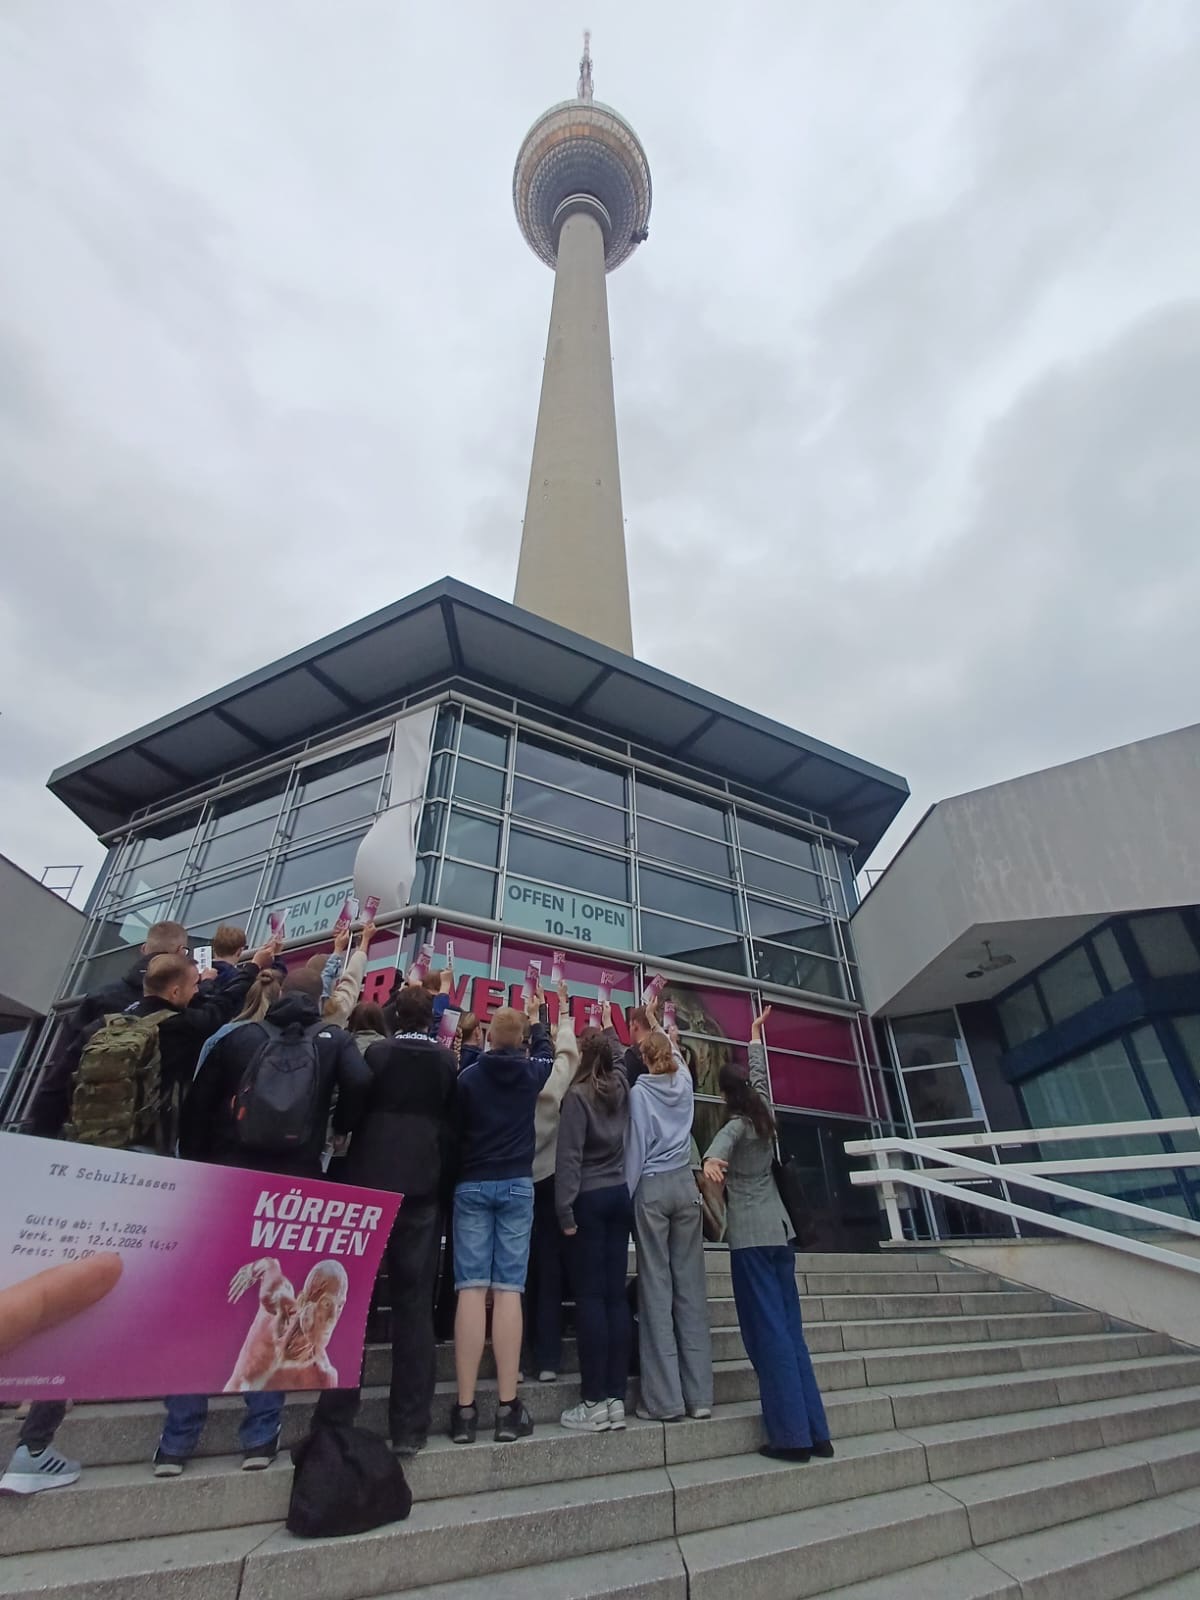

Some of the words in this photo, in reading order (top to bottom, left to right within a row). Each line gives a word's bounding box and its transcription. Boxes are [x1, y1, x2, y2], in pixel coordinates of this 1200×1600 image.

[508, 885, 565, 913] OFFEN
[581, 903, 625, 928] OPEN
[395, 1032, 428, 1041] adidas
[49, 1163, 70, 1177] TK
[76, 1167, 177, 1192] Schulklassen
[253, 1188, 383, 1230] KÖRPER
[19, 1229, 53, 1242] Verk.
[87, 1235, 144, 1249] 12.6.2026
[72, 1219, 93, 1230] ab:
[99, 1221, 148, 1235] 1.1.2024
[250, 1220, 370, 1256] WELTEN
[11, 1244, 55, 1257] Preis:
